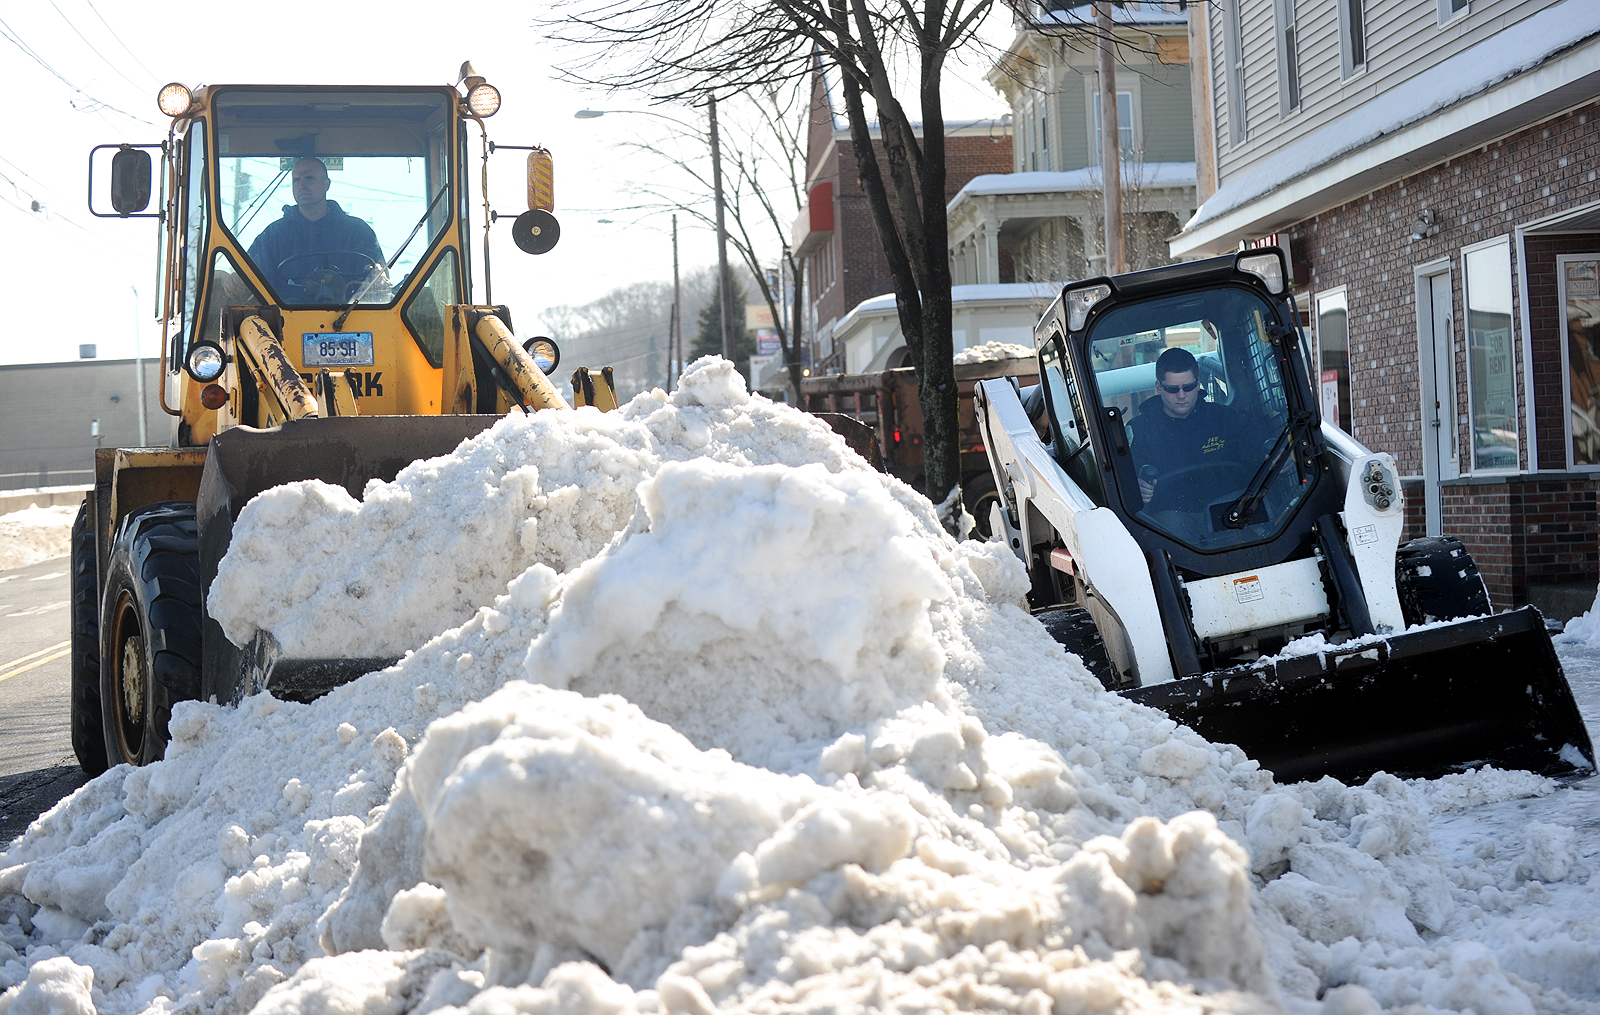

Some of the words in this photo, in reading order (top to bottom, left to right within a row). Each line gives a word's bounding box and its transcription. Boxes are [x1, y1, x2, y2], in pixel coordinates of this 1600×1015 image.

[1568, 282, 1596, 290] UNITED
[1490, 335, 1504, 354] FOR
[1489, 355, 1507, 375] RENT
